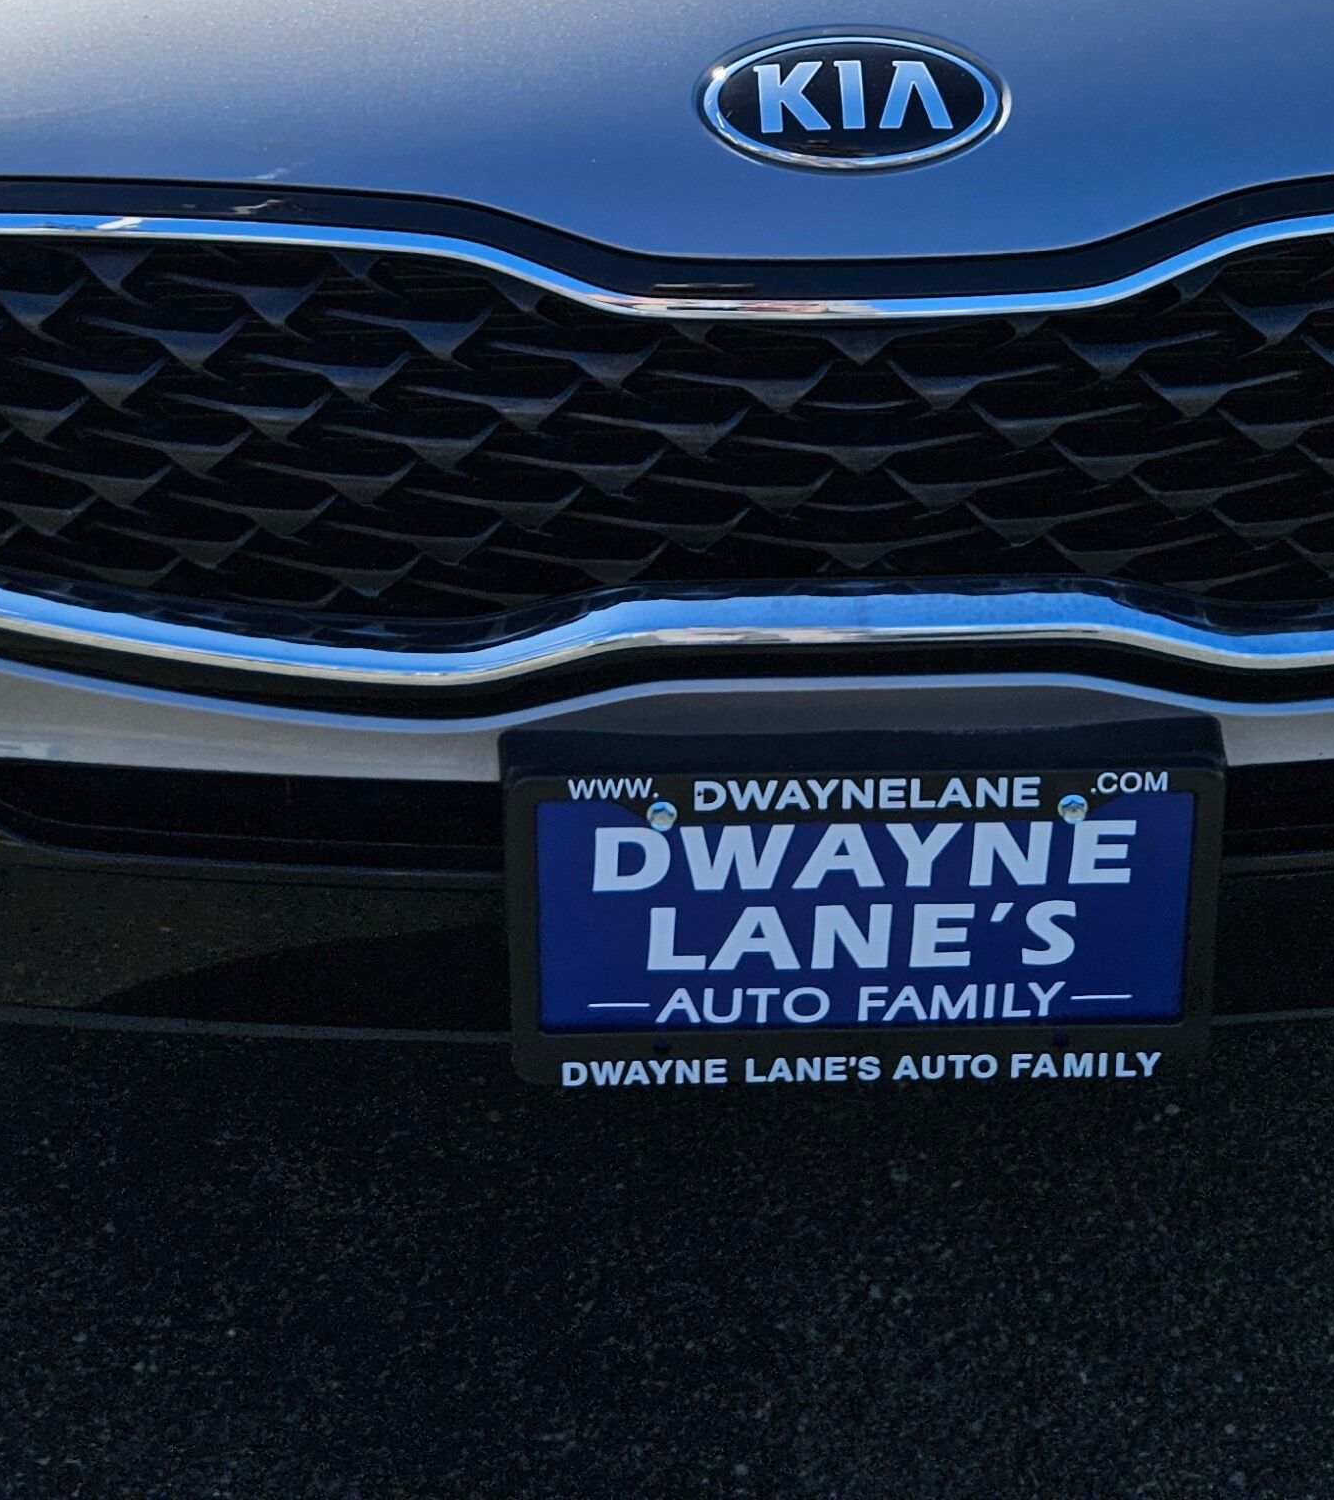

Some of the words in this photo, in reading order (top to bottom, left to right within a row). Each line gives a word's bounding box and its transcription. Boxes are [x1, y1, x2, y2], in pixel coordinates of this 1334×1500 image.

[753, 60, 954, 134] KIA
[693, 776, 1042, 812] DWAYNELANE
[1090, 771, 1169, 794] .COM
[592, 819, 1138, 893] DWAYNE
[646, 900, 1077, 971] LANE'S
[655, 986, 831, 1024] AUTO
[857, 981, 1067, 1022] FAMILY
[561, 1058, 729, 1087] DWAYNE
[745, 1055, 882, 1083] LANE'S
[892, 1053, 999, 1080] AUTO
[1010, 1051, 1163, 1080] FAMILY
